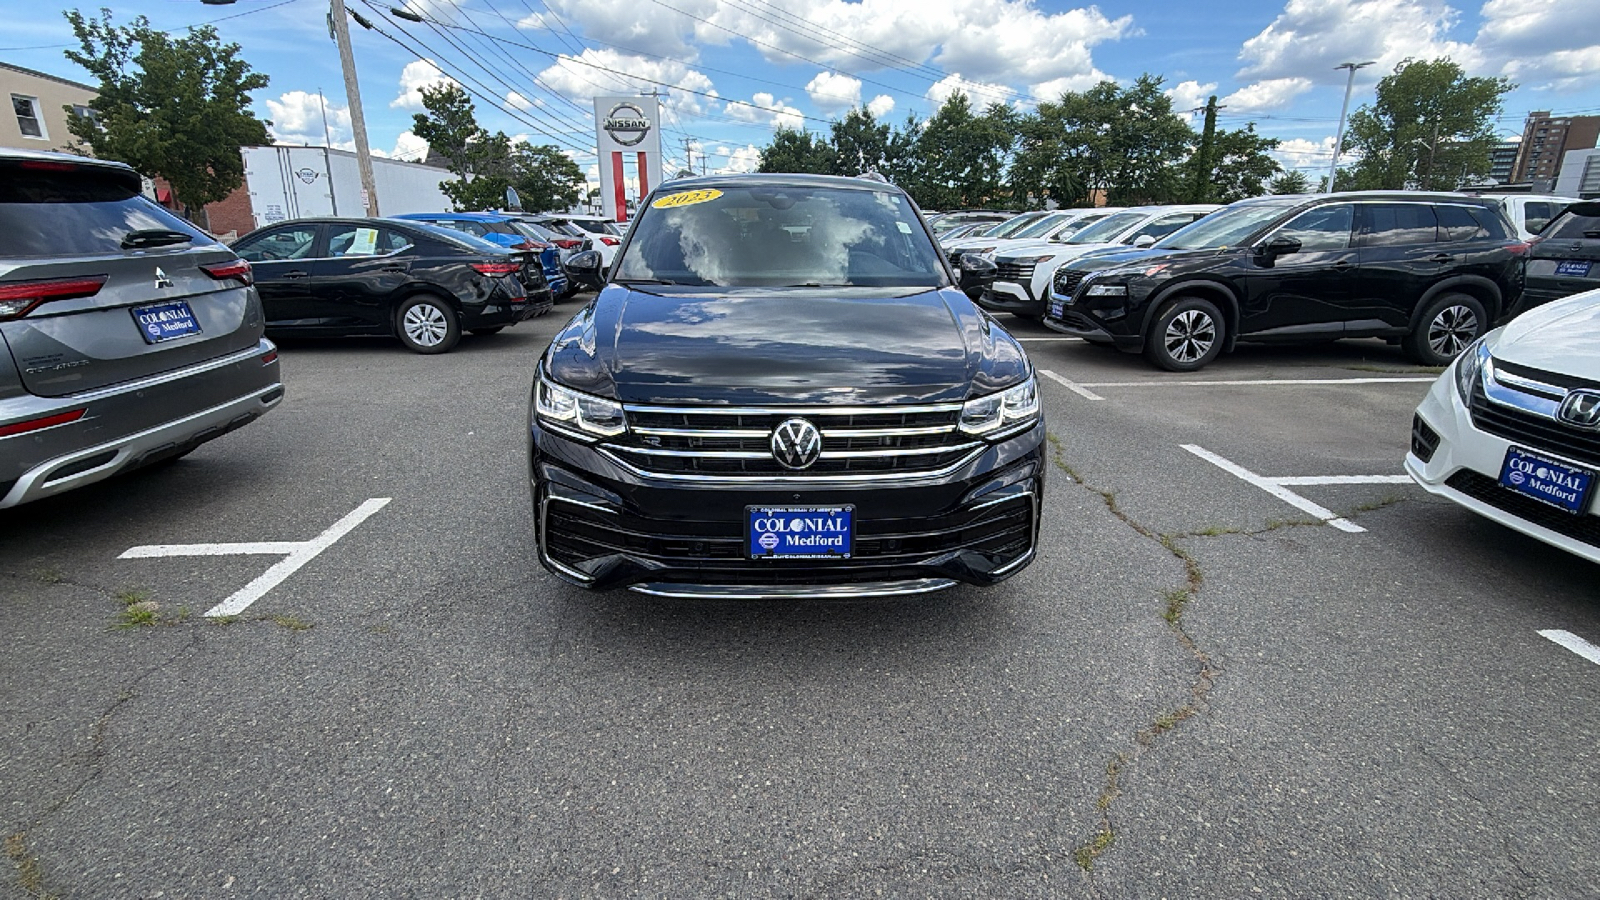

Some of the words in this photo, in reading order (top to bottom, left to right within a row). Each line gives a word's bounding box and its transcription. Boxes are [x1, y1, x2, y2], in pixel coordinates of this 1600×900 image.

[607, 120, 647, 129] NISSAN
[662, 191, 713, 207] 2023
[140, 308, 191, 325] COLONIAL
[161, 319, 194, 332] Medford
[1509, 458, 1583, 492] COLONIAL
[1528, 478, 1577, 503] Medford
[754, 518, 848, 532] COLONIAL
[786, 535, 843, 546] Medford
